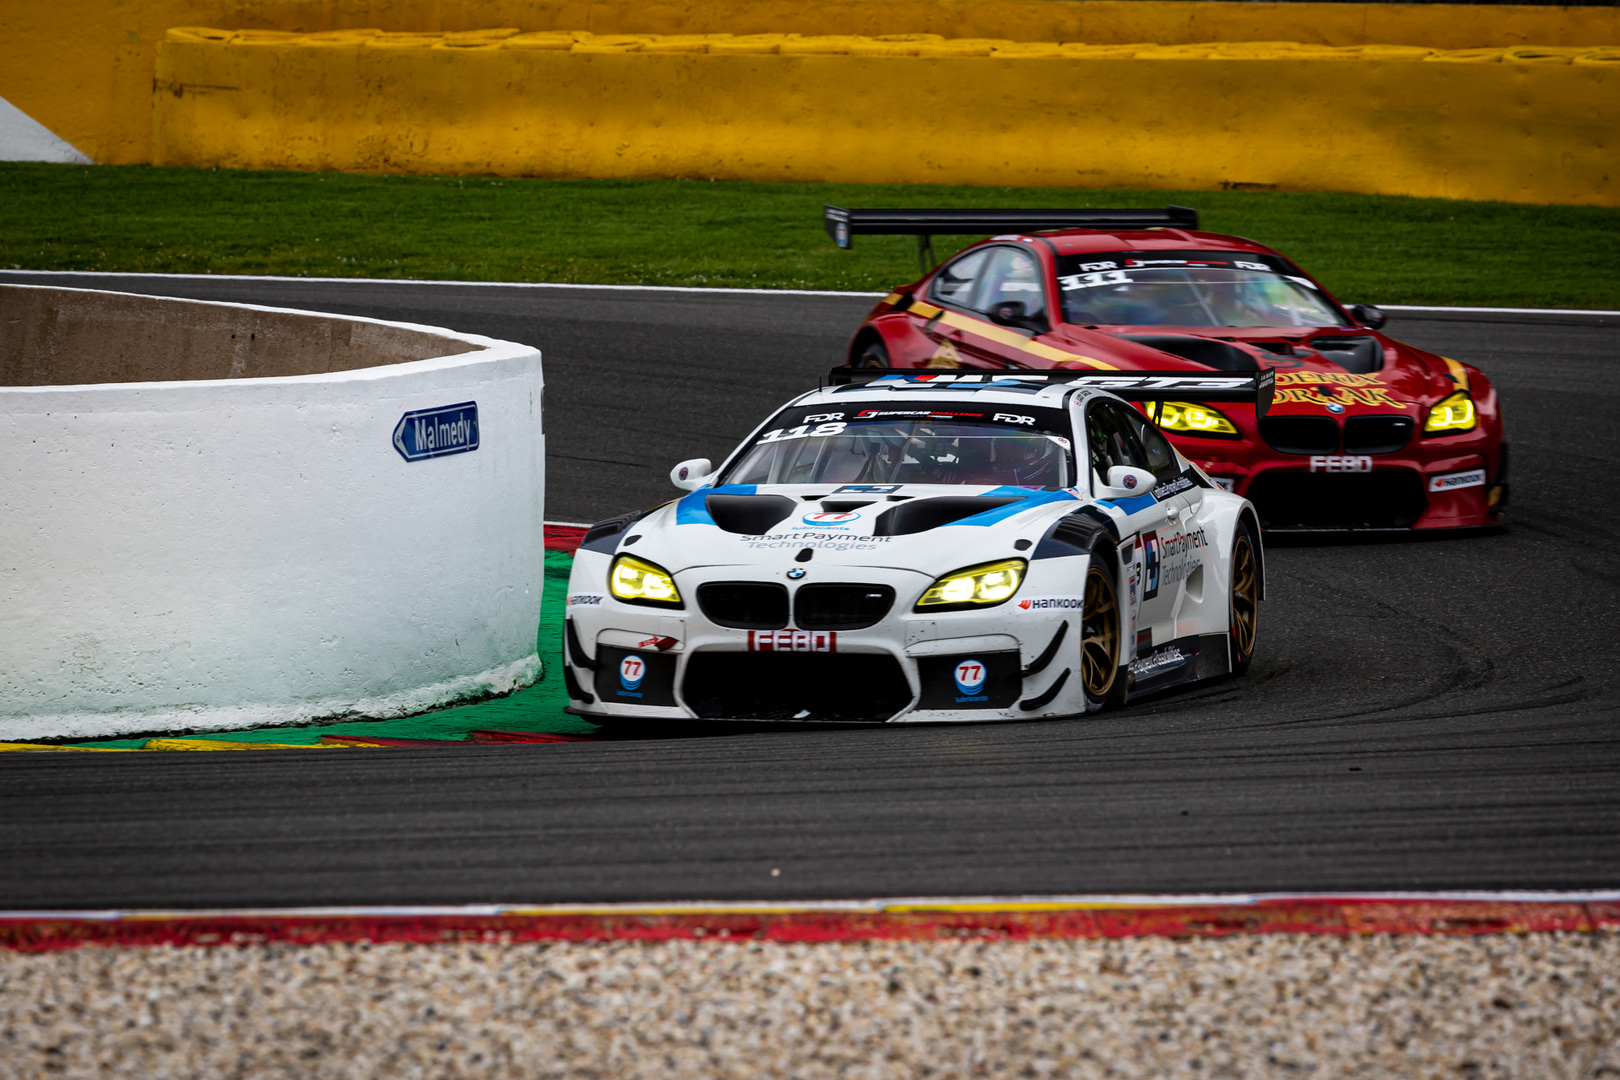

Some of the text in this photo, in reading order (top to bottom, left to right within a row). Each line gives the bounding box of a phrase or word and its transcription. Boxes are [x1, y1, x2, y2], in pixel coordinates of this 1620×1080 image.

[802, 412, 845, 423] FDR
[993, 413, 1036, 426] FDR
[415, 412, 470, 450] Malmedy
[756, 422, 847, 445] 118
[748, 540, 877, 551] Technologies
[754, 631, 830, 652] FEBO
[624, 660, 642, 676] 77
[958, 665, 981, 681] 77
